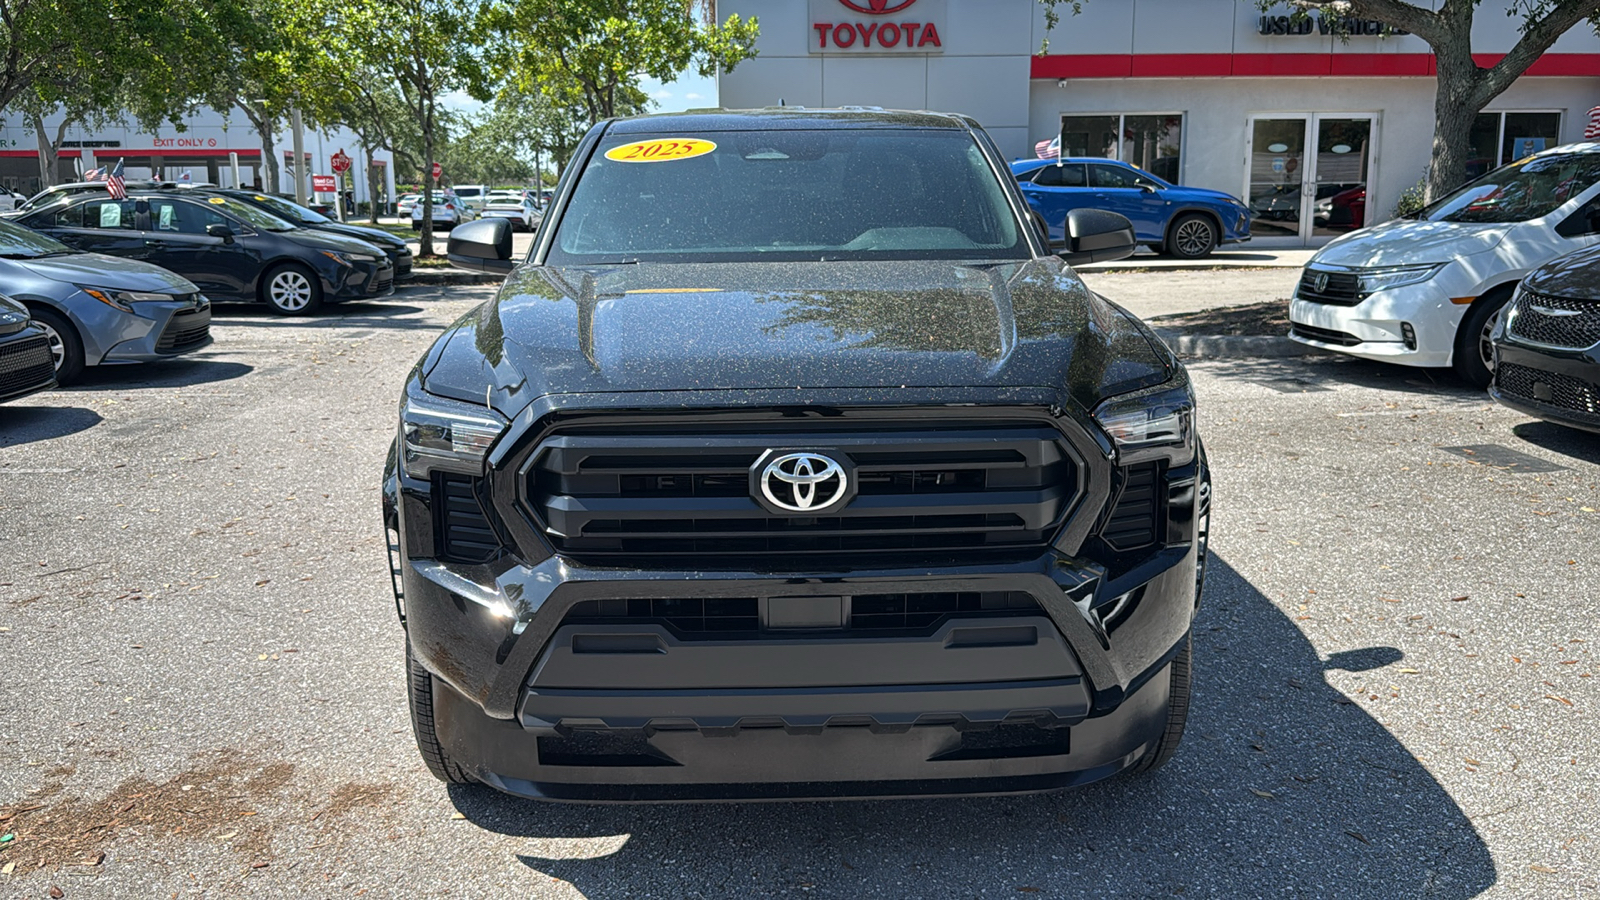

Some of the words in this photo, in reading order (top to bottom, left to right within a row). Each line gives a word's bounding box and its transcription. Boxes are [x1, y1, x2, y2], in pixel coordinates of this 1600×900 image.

[1317, 14, 1410, 36] VHIC
[813, 22, 942, 48] TOYOTA
[153, 138, 175, 147] EXIT
[177, 138, 204, 147] ONLY
[623, 141, 699, 159] 2025
[332, 158, 349, 167] STP
